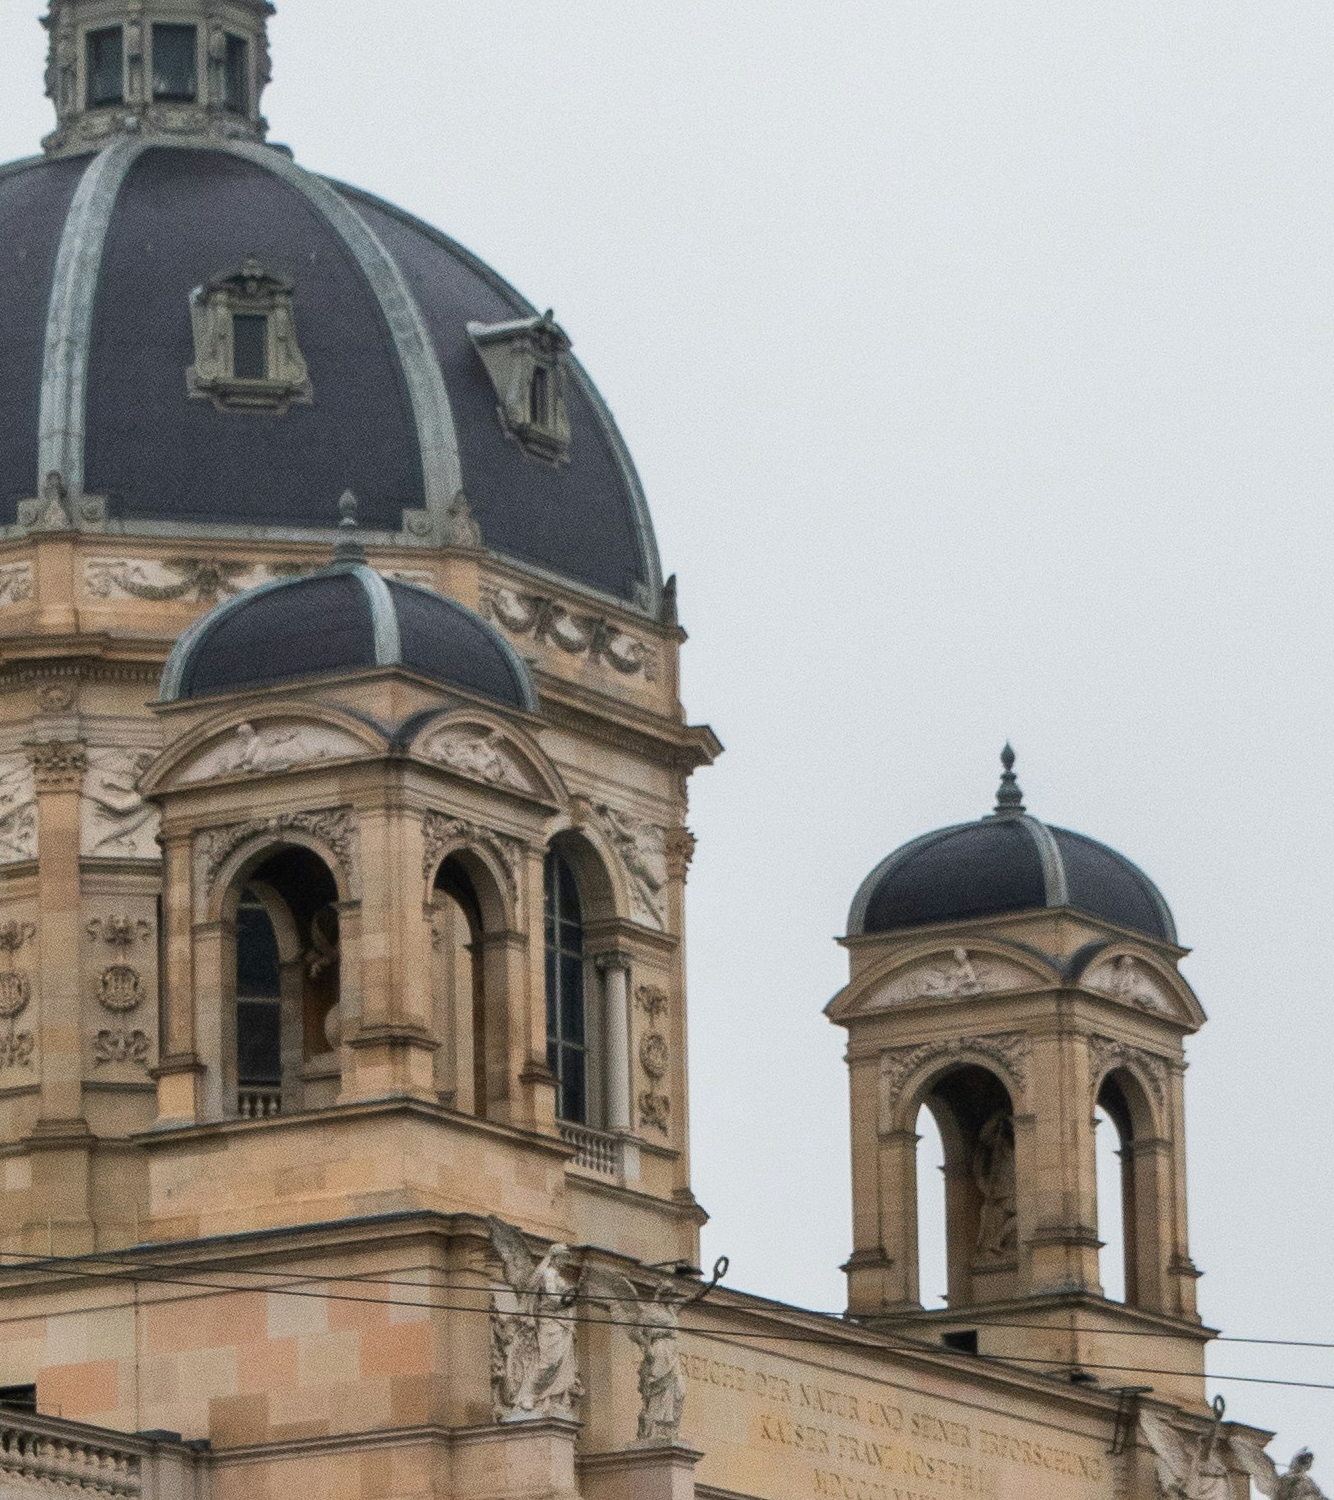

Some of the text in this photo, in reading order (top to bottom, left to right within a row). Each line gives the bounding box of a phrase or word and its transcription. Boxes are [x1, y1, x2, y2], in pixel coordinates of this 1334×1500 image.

[678, 1352, 1103, 1482] REICHE DER NATUR UND SEINER ERFORSCHUNG
[760, 1414, 830, 1454] KAISER
[837, 1434, 893, 1471] FRANZ
[902, 1450, 974, 1491] JOSEPH
